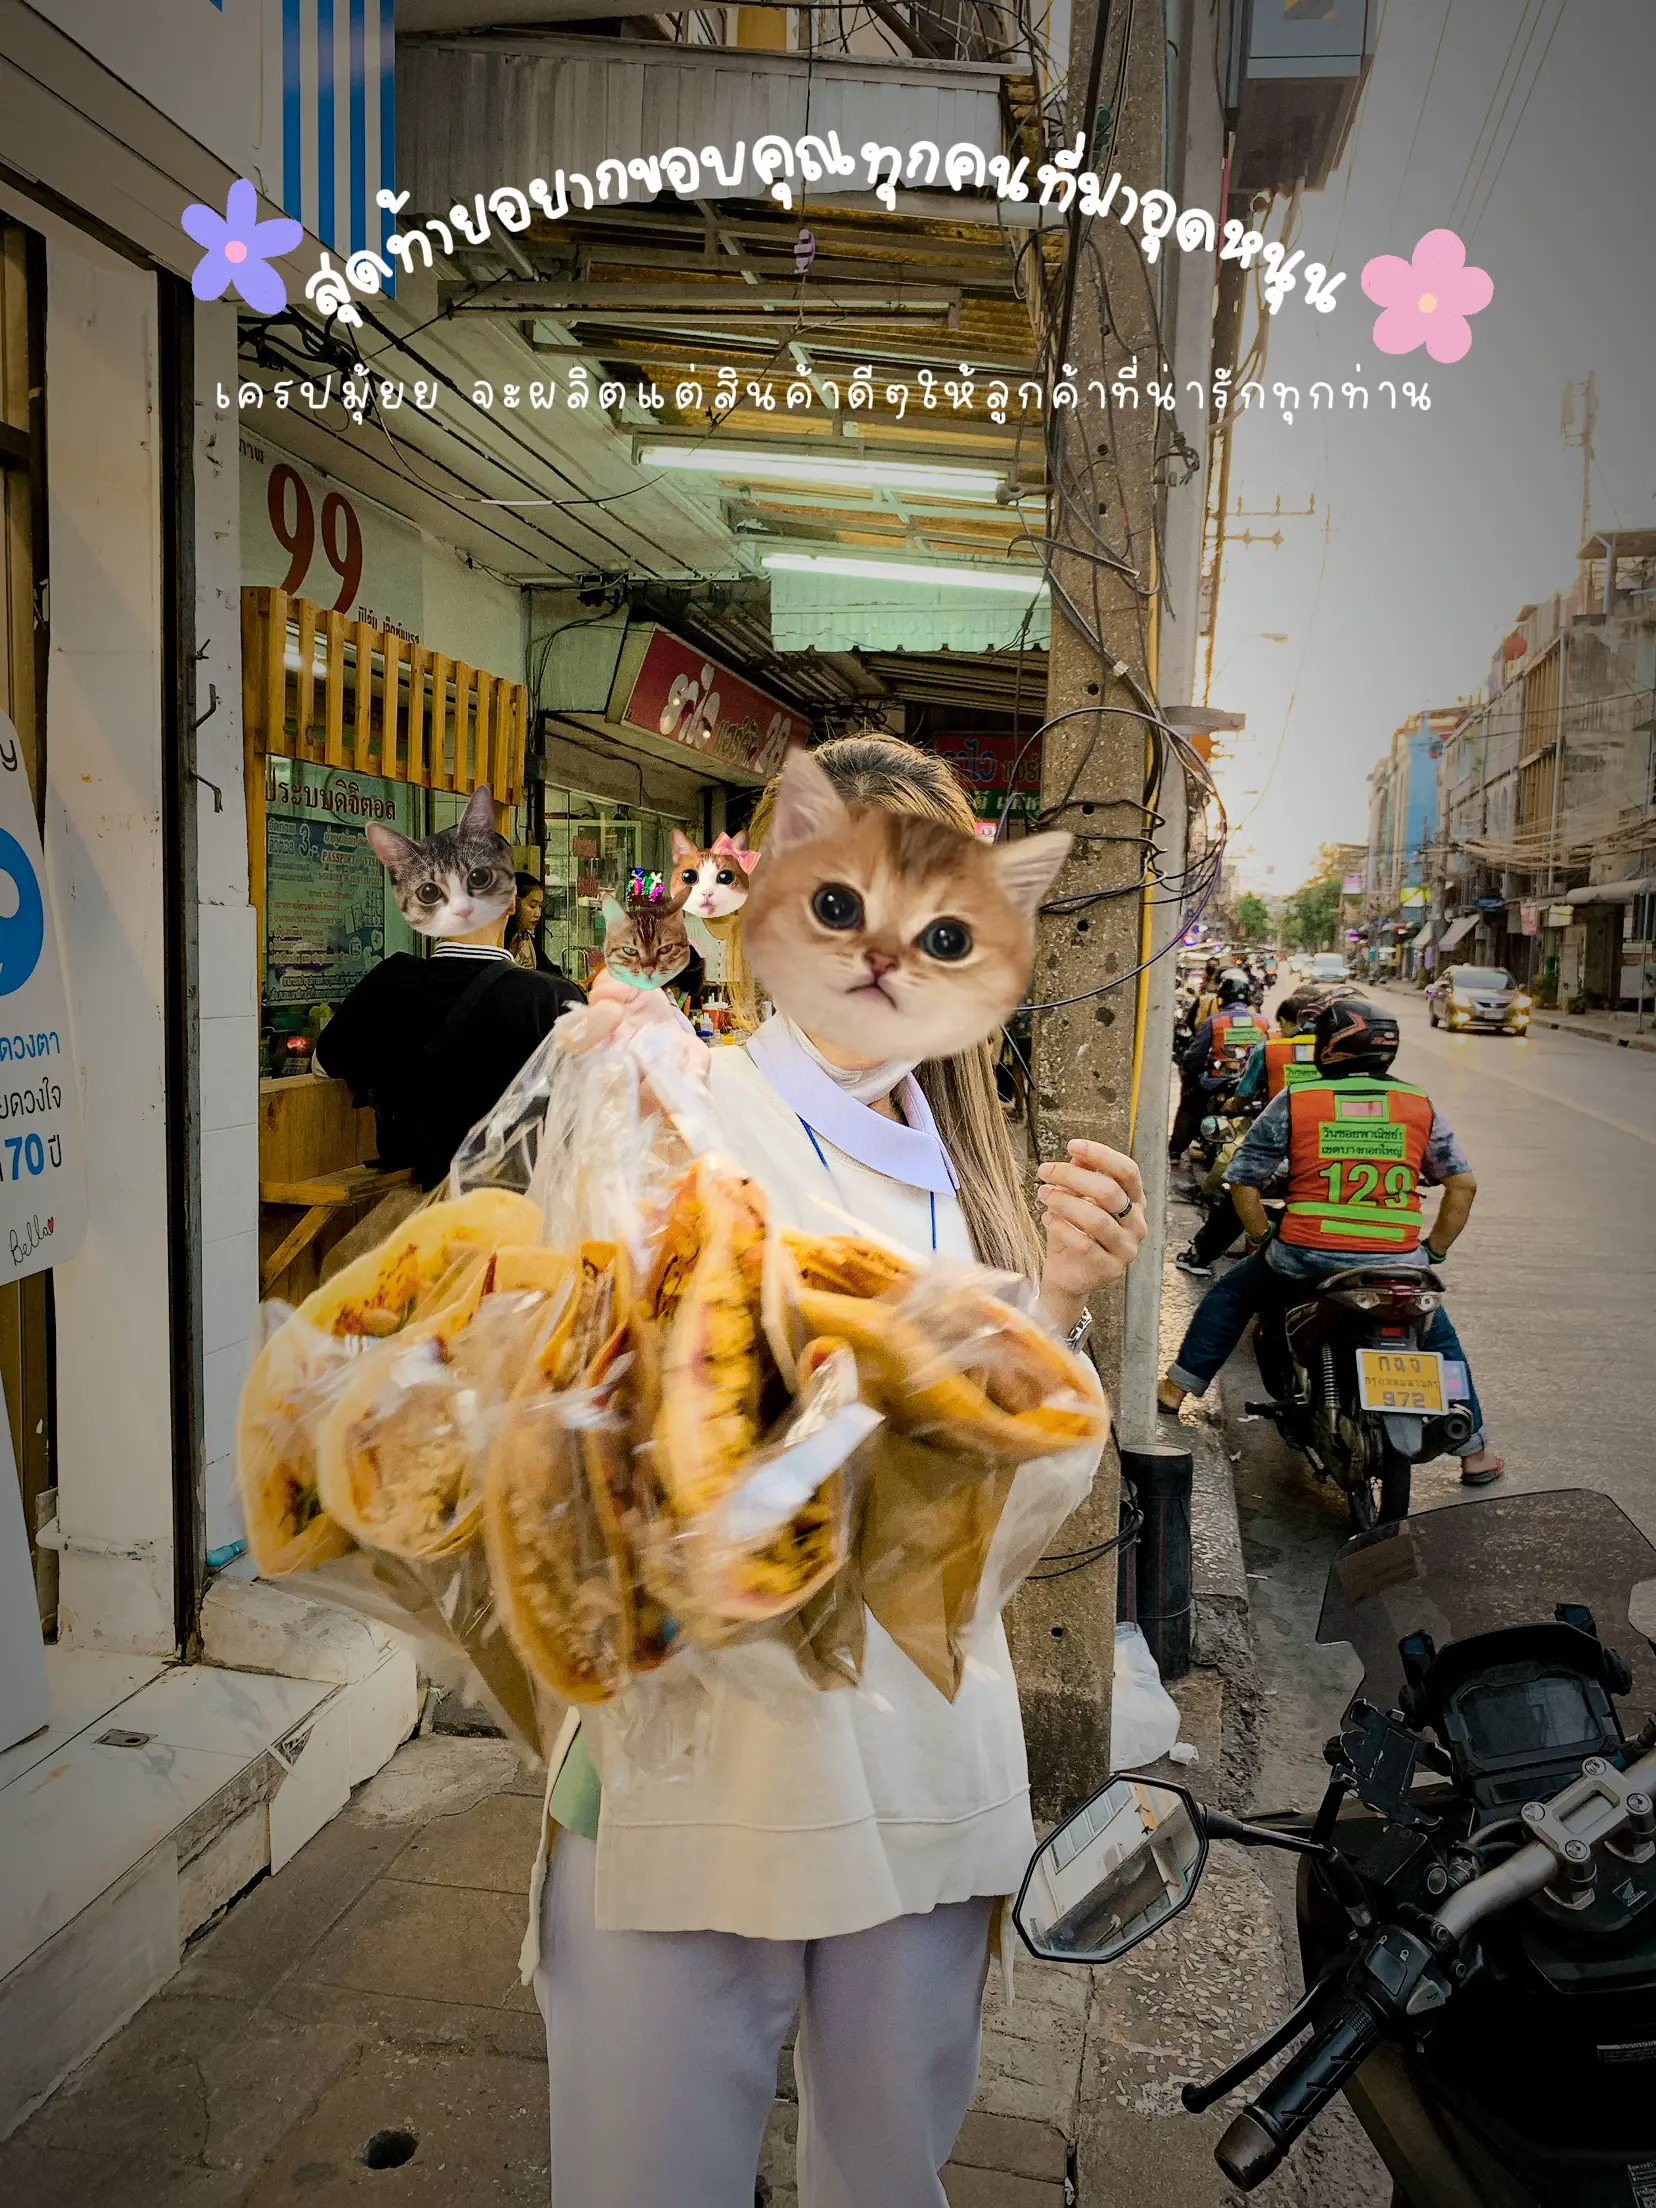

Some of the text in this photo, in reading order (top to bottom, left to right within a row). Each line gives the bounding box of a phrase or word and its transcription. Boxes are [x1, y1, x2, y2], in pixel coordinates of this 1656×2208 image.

[267, 462, 363, 614] 99
[4, 1133, 45, 1181] 70
[47, 1134, 62, 1168] ปี
[1318, 1160, 1412, 1208] 129
[9, 1214, 49, 1266] Bella
